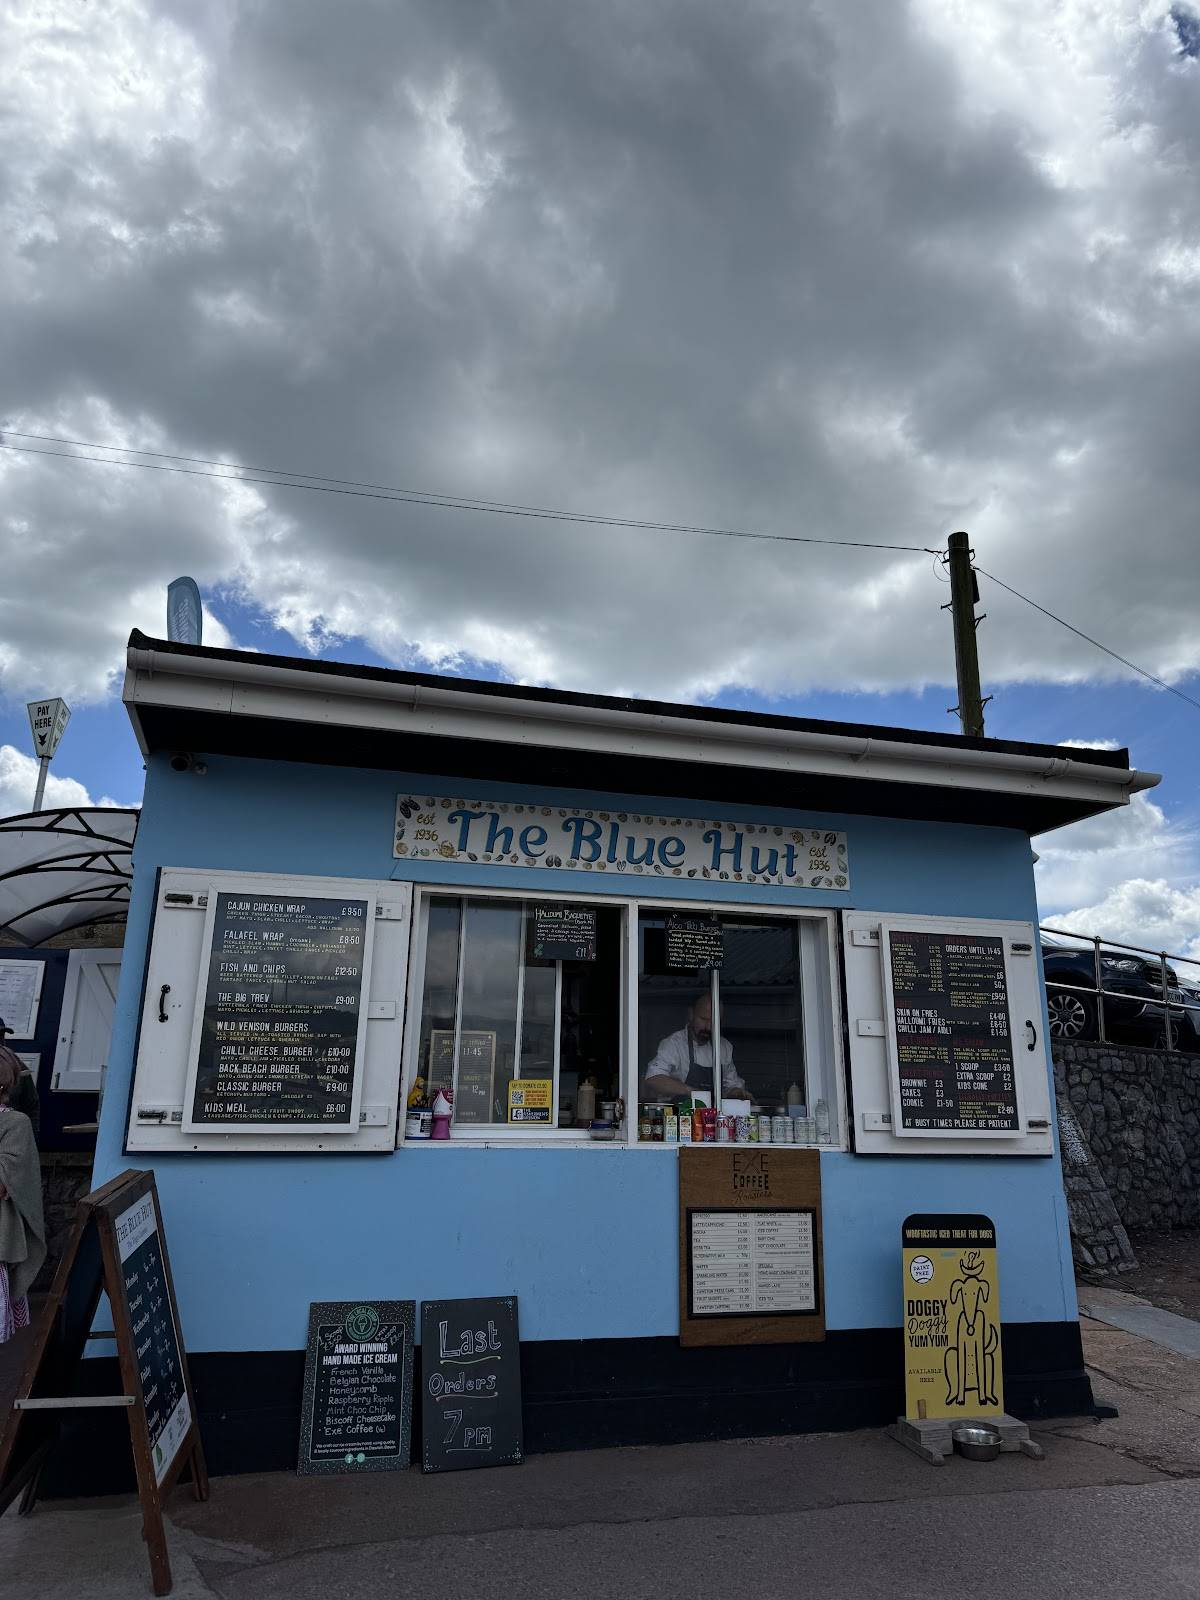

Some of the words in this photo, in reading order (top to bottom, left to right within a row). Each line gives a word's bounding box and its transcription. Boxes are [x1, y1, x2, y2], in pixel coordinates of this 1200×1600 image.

[37, 705, 50, 717] PAY
[34, 717, 52, 730] HERE
[416, 812, 435, 826] est
[413, 828, 439, 842] 1936
[447, 809, 548, 858] The
[561, 817, 686, 869] Blue
[702, 829, 798, 878] Hut
[808, 859, 831, 872] 1936
[227, 901, 251, 911] CAJUN
[253, 903, 284, 913] CHICKEN
[286, 904, 306, 914] WRAP
[224, 930, 258, 940] FALAFEL
[262, 931, 285, 942] WRAP
[945, 944, 968, 954] ORDERS
[968, 946, 988, 955] UNTIL
[220, 962, 239, 972] FISH
[242, 963, 258, 973] AND
[262, 964, 286, 974] CHIPS
[217, 992, 233, 1002] THE
[235, 993, 248, 1003] BIG
[250, 993, 270, 1003] TREV
[896, 1008, 910, 1017] SKIN
[911, 1009, 920, 1017] ON
[921, 1009, 938, 1018] FRIES
[216, 1021, 236, 1031] WILD
[238, 1021, 270, 1031] VENISON
[274, 1022, 309, 1032] BURGERS
[928, 1017, 946, 1026] FRIES
[897, 1024, 918, 1033] CHILLI
[221, 1046, 245, 1056] CHILLI
[249, 1046, 279, 1056] CHEESE
[283, 1047, 313, 1057] BURGER
[219, 1063, 240, 1073] BACK
[242, 1064, 268, 1074] BEACH
[270, 1064, 300, 1074] BURGER
[960, 1062, 980, 1071] SCOOP
[956, 1071, 974, 1080] EXTRA
[975, 1072, 995, 1081] SCOOP
[1003, 1073, 1011, 1081] £2
[216, 1082, 250, 1092] CLASSIC
[252, 1082, 282, 1092] BURGER
[901, 1078, 928, 1088] BROWNIE
[935, 1079, 944, 1088] £3
[957, 1081, 972, 1090] KIDS
[972, 1082, 989, 1091] CONE
[1004, 1082, 1013, 1091] £2
[901, 1088, 922, 1097] CAKES
[935, 1089, 944, 1098] £3
[204, 1102, 224, 1113] KIDS
[226, 1103, 248, 1113] MEAL
[902, 1098, 925, 1107] COOKIE
[905, 1118, 912, 1127] AT
[915, 1118, 931, 1127] BUSY
[932, 1118, 953, 1128] TIMES
[954, 1119, 977, 1128] PLEASE
[978, 1119, 987, 1128] BE
[988, 1119, 1012, 1129] PATIENT
[733, 1152, 769, 1173] EXE
[733, 1173, 769, 1190] COFFEE
[907, 1299, 947, 1316] DOGGY
[907, 1315, 949, 1336] Doggy
[438, 1320, 502, 1359] Last
[908, 1335, 928, 1348] YUM
[928, 1335, 949, 1347] YUM
[334, 1343, 359, 1354] AWARD
[359, 1342, 388, 1353] WINNING
[322, 1355, 342, 1365] HAND
[342, 1354, 363, 1365] MADE
[363, 1354, 374, 1364] ICE
[374, 1353, 398, 1363] CREAM
[331, 1367, 358, 1376] French
[361, 1366, 384, 1375] Vanilla
[329, 1376, 360, 1387] Belgian
[361, 1373, 397, 1385] Chocolate
[428, 1372, 497, 1396] Orders
[329, 1384, 378, 1396] Honeycomb
[328, 1395, 372, 1407] Raspberry
[373, 1394, 394, 1406] Ripple
[326, 1406, 345, 1415] Mint
[347, 1406, 367, 1415] Choc
[368, 1405, 387, 1415] Chip
[325, 1416, 353, 1426] Biscoff
[356, 1411, 396, 1424] Cheesecake
[346, 1423, 374, 1434] Coffee
